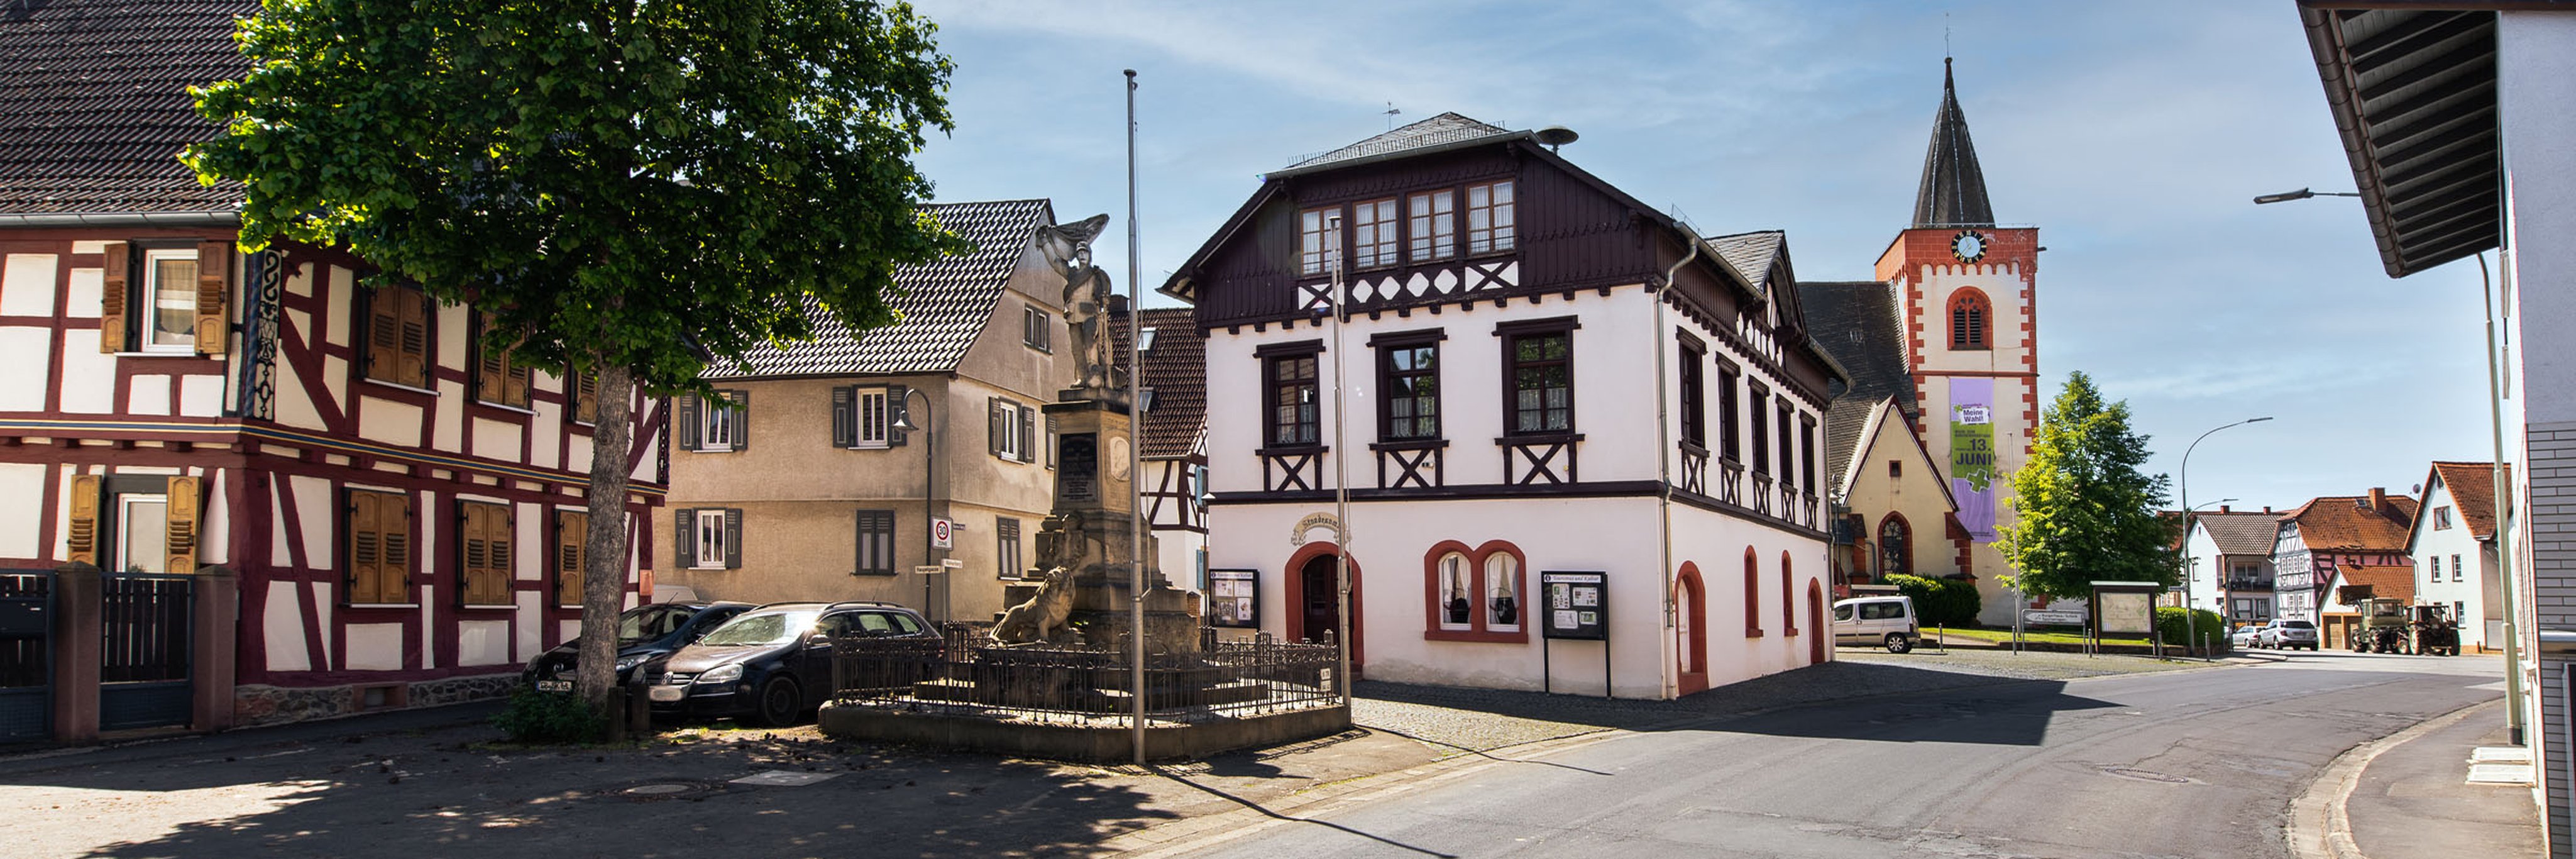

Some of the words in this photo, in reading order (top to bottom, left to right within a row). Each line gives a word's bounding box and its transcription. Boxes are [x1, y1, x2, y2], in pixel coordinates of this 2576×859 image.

[1969, 439, 1991, 452] 13.
[1302, 514, 1340, 529] Standesam
[939, 526, 946, 535] 30
